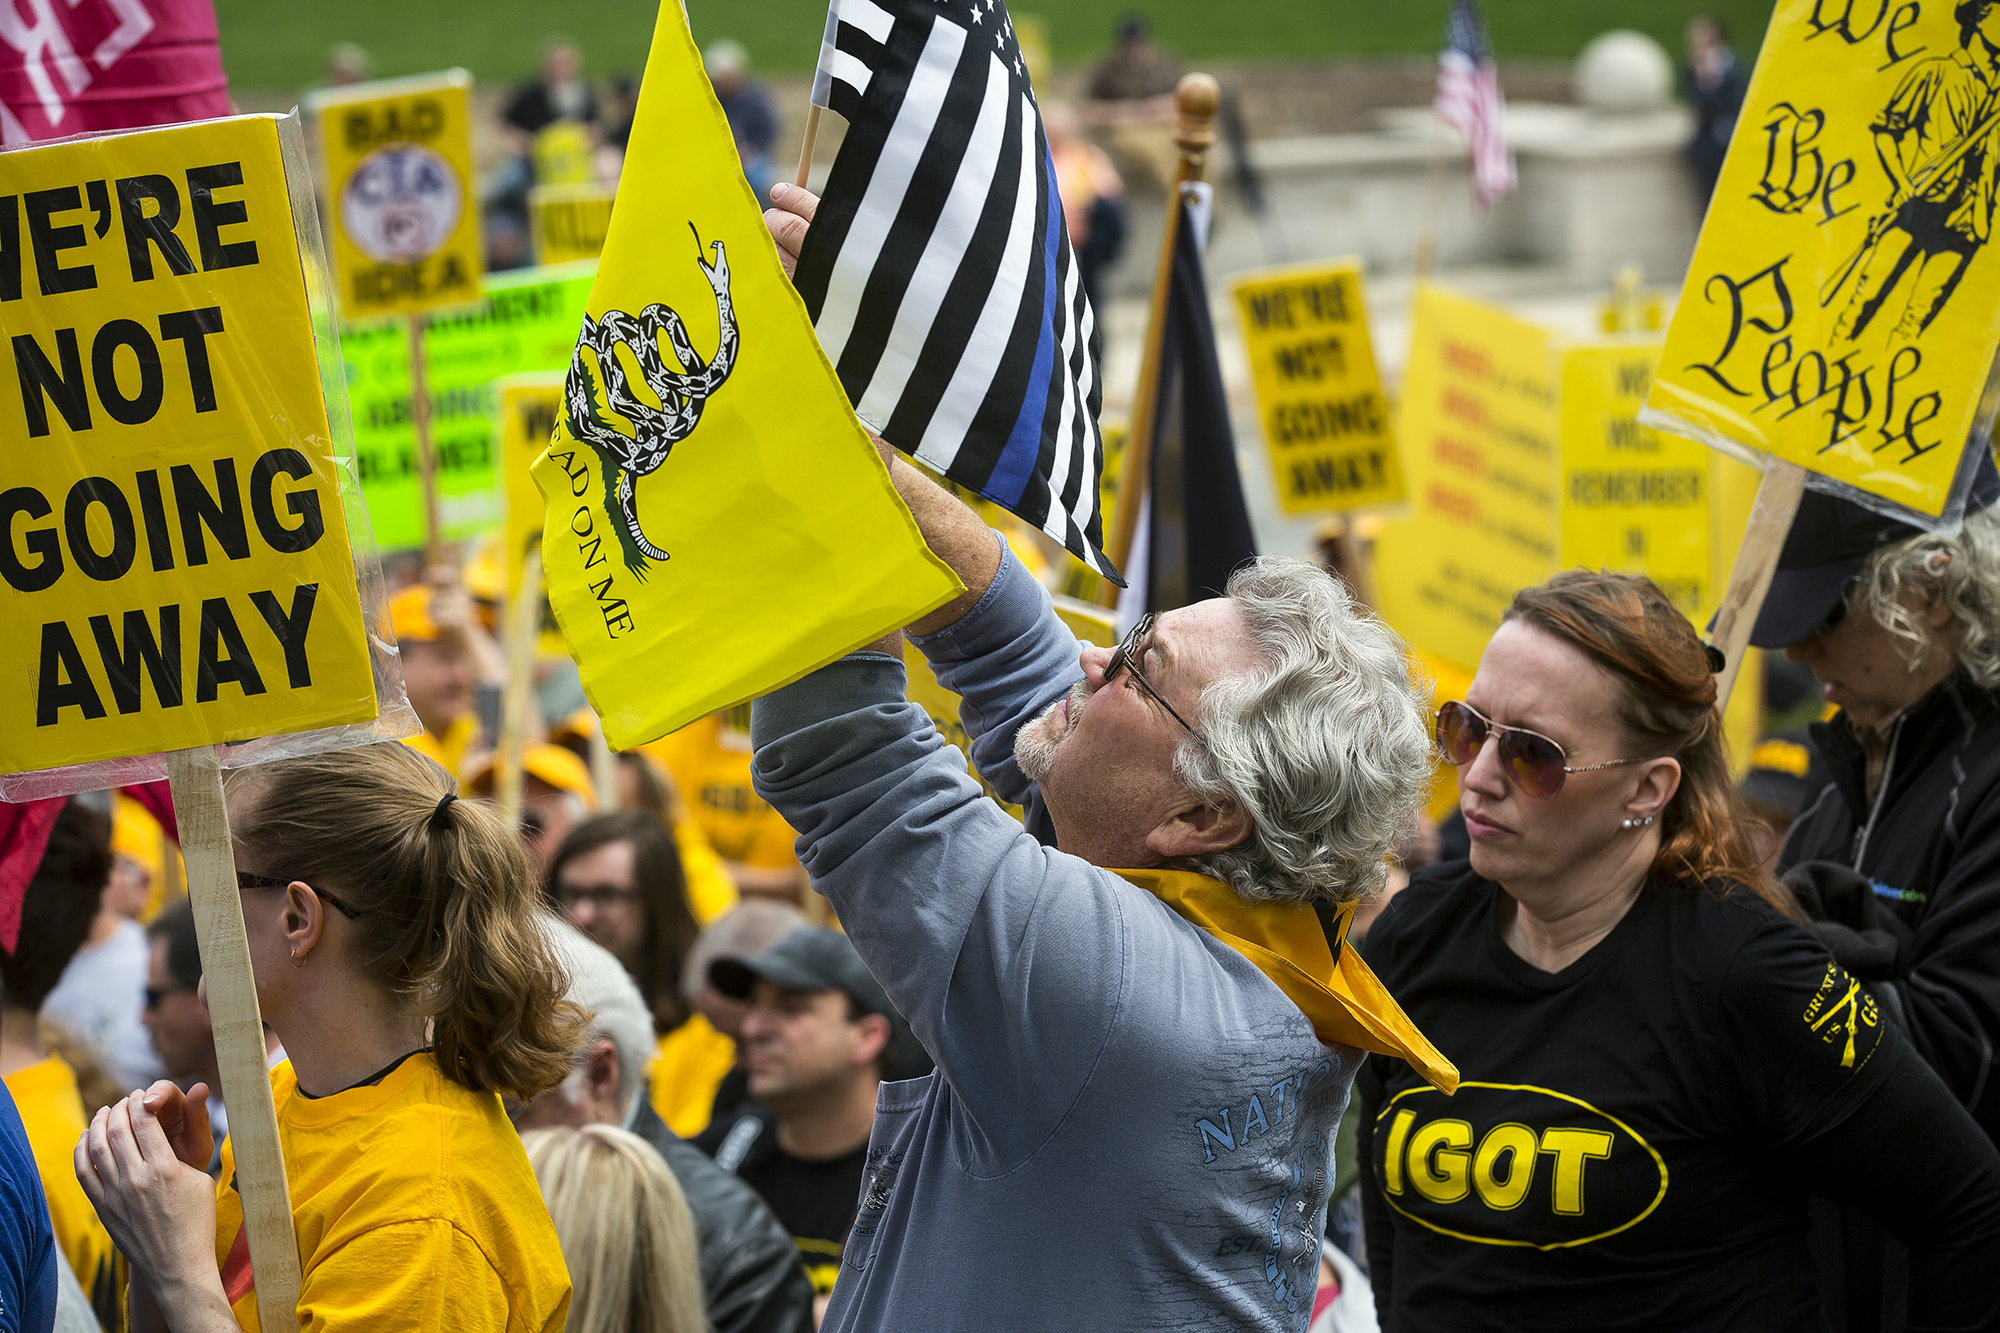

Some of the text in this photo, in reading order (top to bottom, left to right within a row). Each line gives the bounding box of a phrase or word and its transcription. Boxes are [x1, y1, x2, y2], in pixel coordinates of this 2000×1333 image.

[344, 98, 445, 147] BAD
[1749, 102, 1861, 227] Be
[0, 162, 260, 301] E'RE
[353, 255, 466, 305] IDEA
[11, 306, 225, 438] NOT
[1273, 335, 1345, 381] NOT
[1683, 254, 1942, 464] People
[1272, 391, 1386, 447] GOING
[1289, 449, 1388, 498] AWAY
[1569, 470, 1702, 508] REMEMBER
[0, 448, 325, 592] GOING
[571, 505, 608, 570] ON
[588, 573, 636, 640] ME
[37, 583, 319, 727] AWAY
[1803, 973, 1835, 1023] GRUNT
[1822, 1022, 1842, 1044] US
[1384, 1108, 1615, 1217] IGOT
